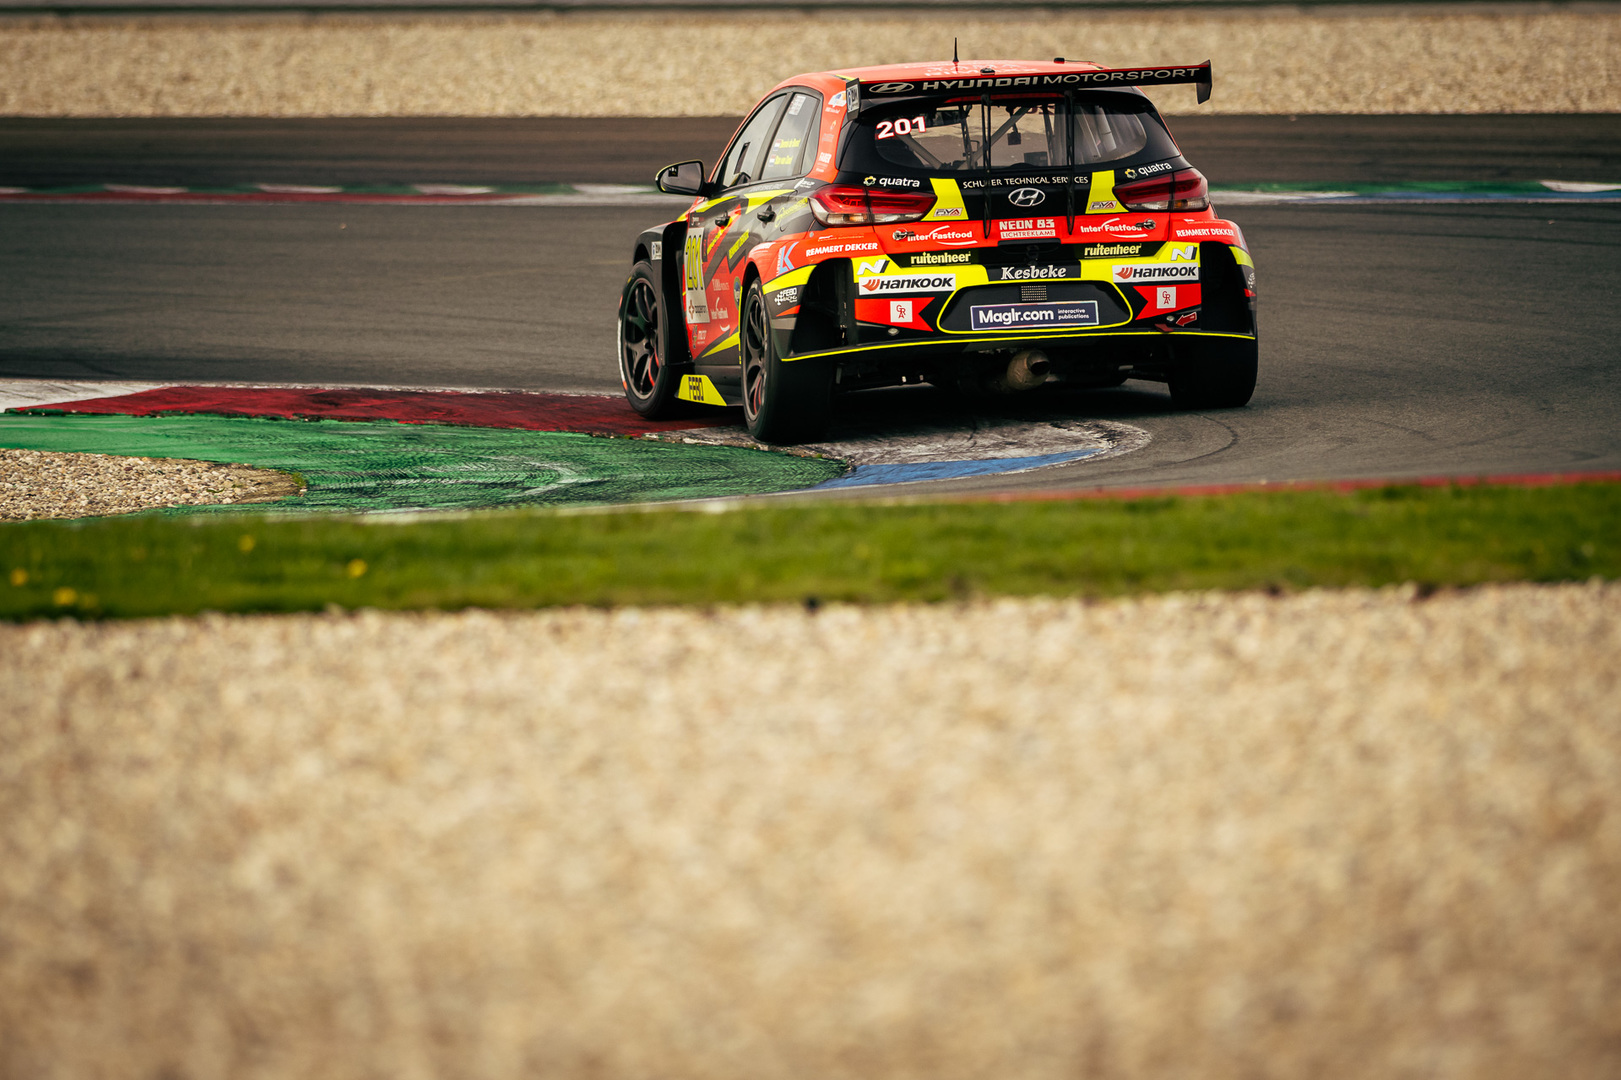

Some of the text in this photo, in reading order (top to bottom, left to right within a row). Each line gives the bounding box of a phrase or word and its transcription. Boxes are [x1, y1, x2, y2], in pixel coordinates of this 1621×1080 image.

[922, 76, 1039, 90] HYUNDAI
[1043, 68, 1200, 84] MOTORSPORT
[876, 116, 926, 139] 201
[1138, 162, 1172, 176] quatra
[879, 176, 920, 188] quatra
[1004, 176, 1050, 185] TECHNICAL
[999, 219, 1055, 230] NEON 83
[1080, 225, 1101, 233] Inter
[907, 231, 973, 242] Inter Fastfood
[1001, 230, 1055, 238] LICHTREKLAME
[1176, 228, 1210, 237] REMMERT
[806, 242, 878, 257] REMMERT DEKKER
[1084, 243, 1142, 256] ruitenheer
[684, 234, 704, 290] 201
[911, 251, 971, 264] ruitenheer
[1001, 265, 1067, 280] Kesbeke
[1133, 266, 1197, 278] HANKOOK
[879, 277, 954, 290] HANKOOK
[979, 308, 1054, 325] Maglr.com
[1058, 313, 1090, 321] publications
